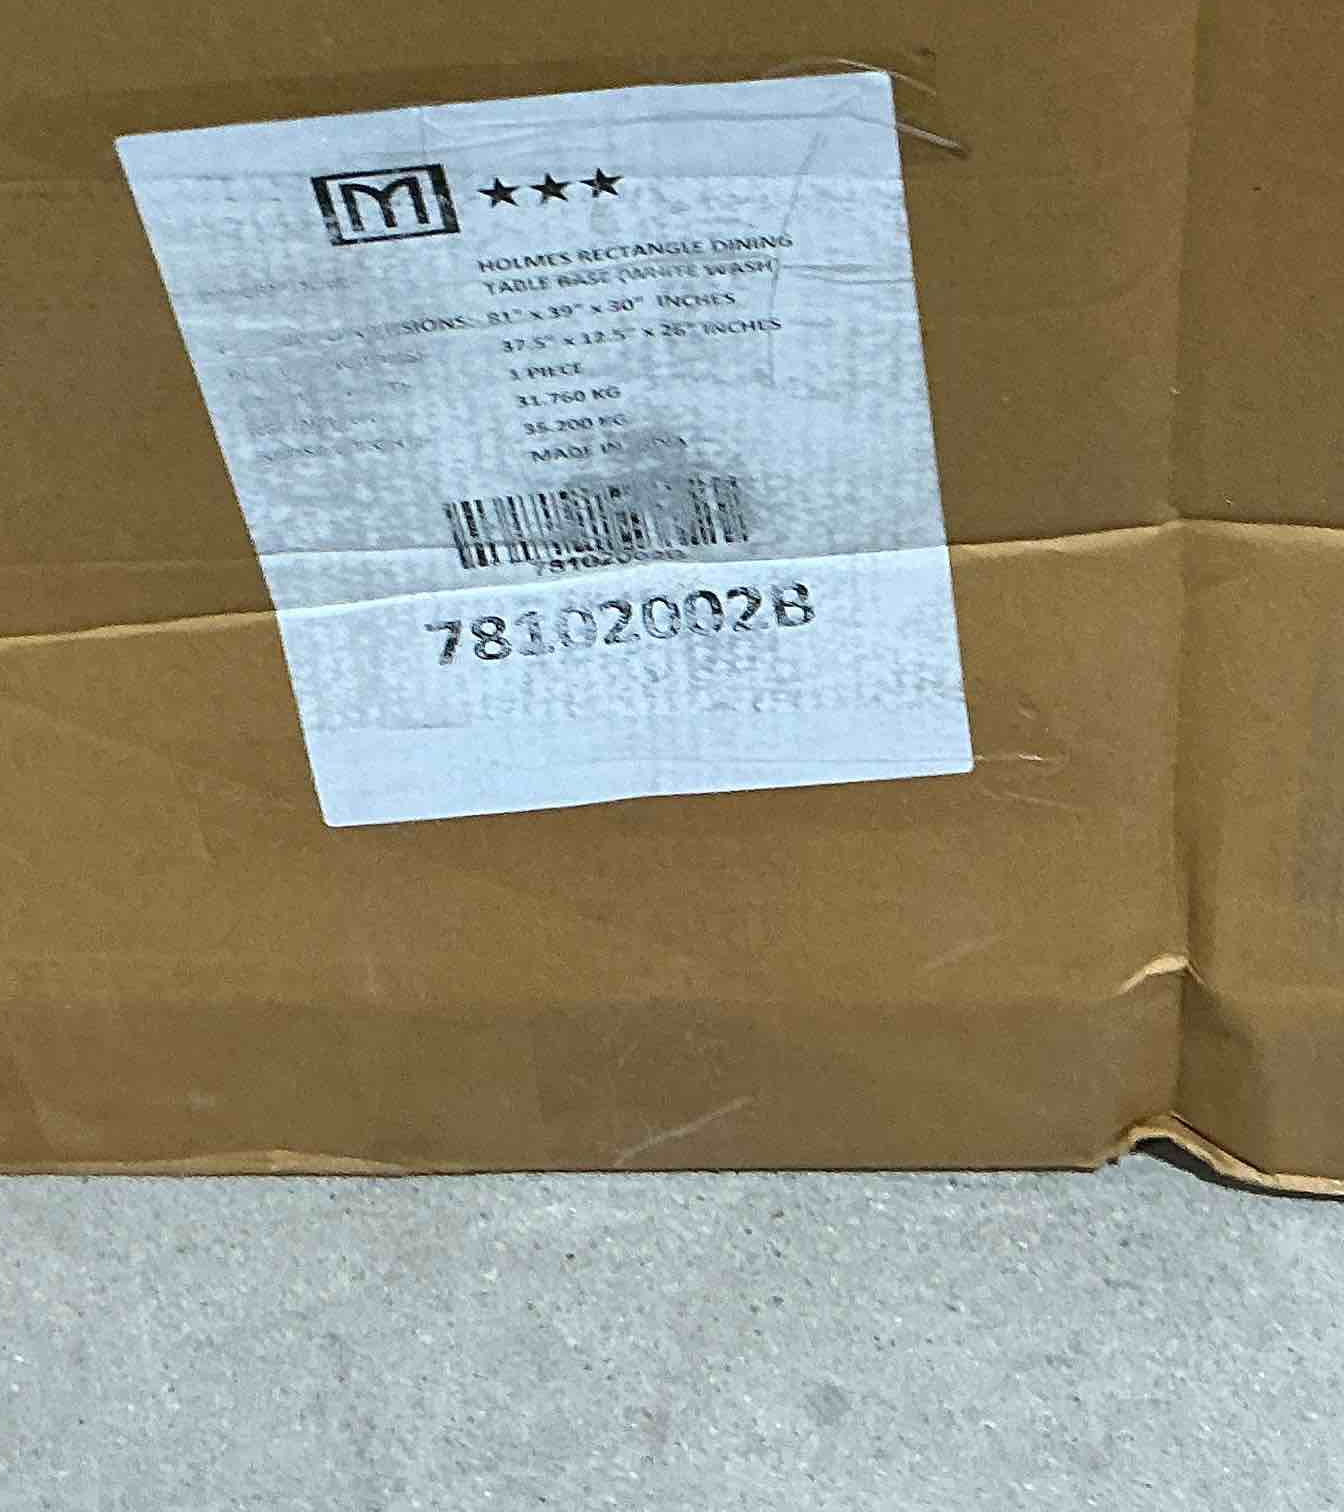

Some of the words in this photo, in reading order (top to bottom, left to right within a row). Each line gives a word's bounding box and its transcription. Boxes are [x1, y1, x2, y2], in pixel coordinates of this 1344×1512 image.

[477, 251, 573, 273] HOLMES
[576, 240, 705, 264] RECTANGLE
[711, 232, 793, 253] DINING
[482, 276, 549, 296] TABLE
[656, 290, 737, 310] INCHES
[703, 316, 784, 337] INCHES
[526, 361, 583, 381] PIECE
[590, 385, 622, 401] KG
[530, 444, 593, 464] MADE
[599, 438, 624, 455] IN
[423, 581, 818, 666] 78102002B
